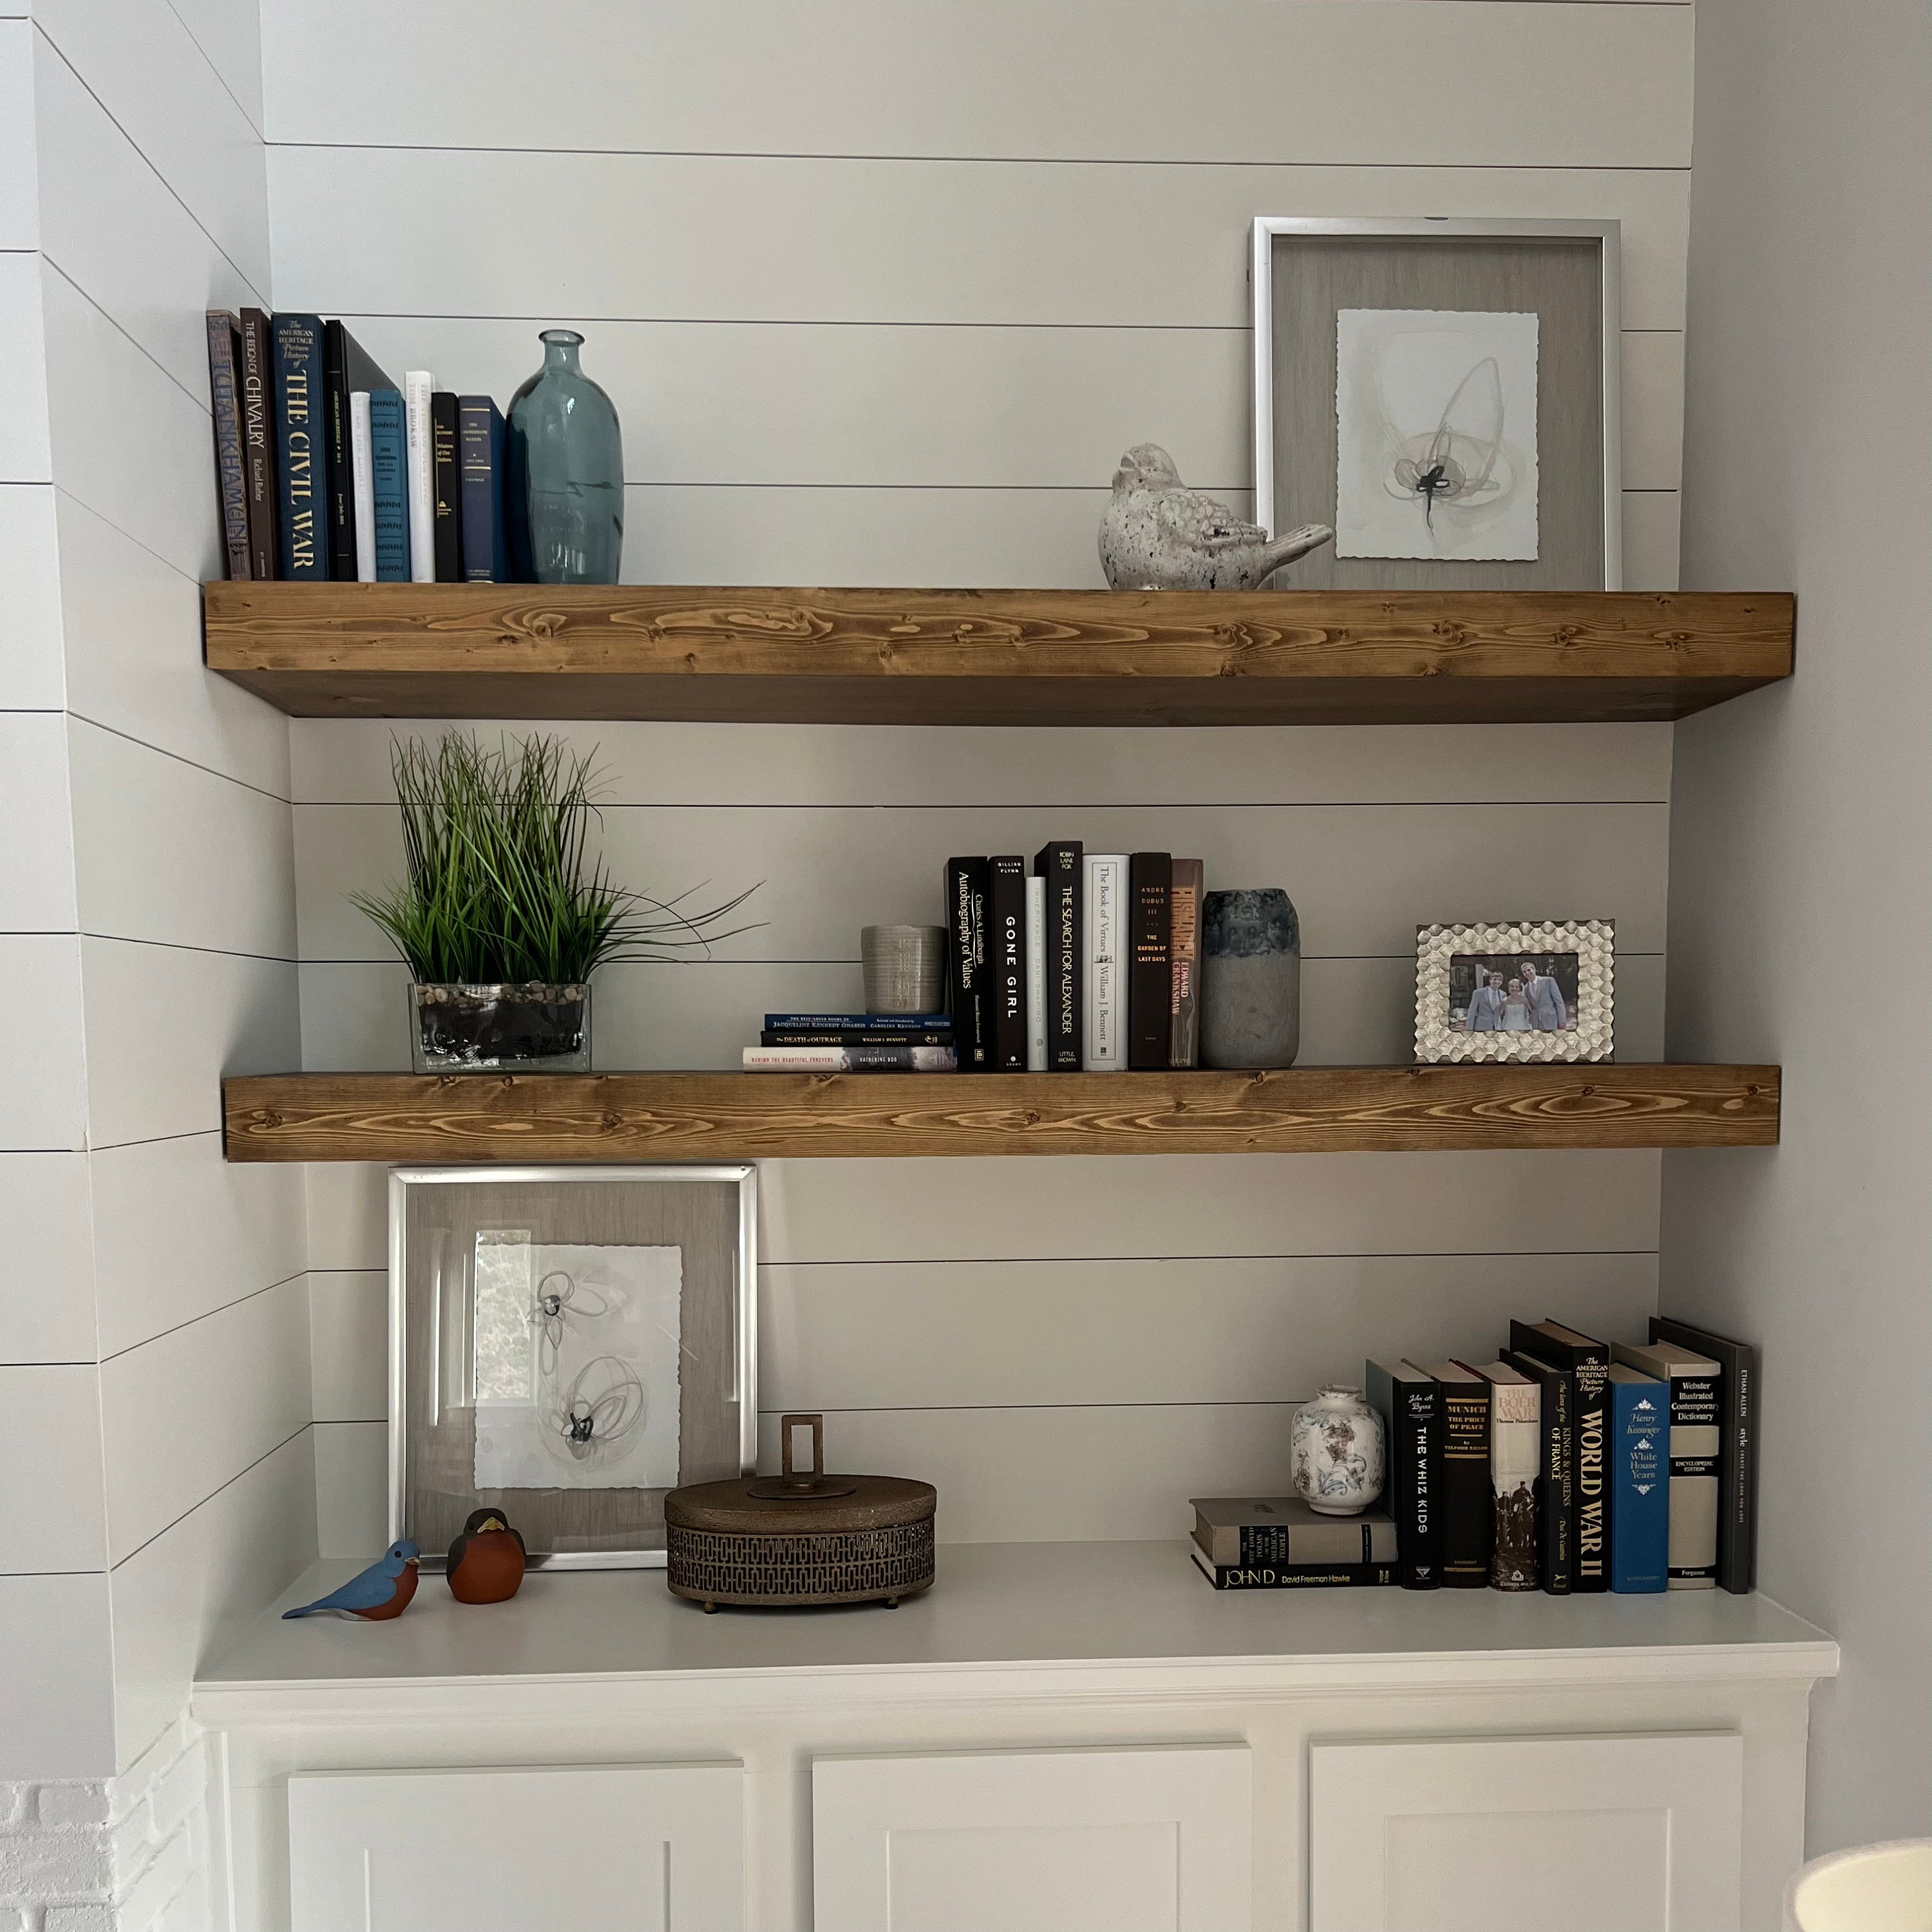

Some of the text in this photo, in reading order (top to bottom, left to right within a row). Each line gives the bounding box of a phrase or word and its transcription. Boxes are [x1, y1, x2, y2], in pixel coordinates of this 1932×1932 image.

[245, 321, 254, 338] THE
[278, 336, 314, 345] HERITAGE
[245, 339, 256, 363] REIGN
[248, 363, 257, 374] OF
[246, 376, 264, 449] CHIVALRY
[287, 370, 316, 569] THE CIVIL WAR
[975, 895, 983, 921] Charles
[1101, 866, 1110, 952] The Book of Virtues
[958, 871, 973, 989] Autobiography of Values
[976, 929, 985, 964] Lindbergh
[1006, 916, 1017, 1018] GONE GIRL
[1062, 886, 1072, 1034] THE SEARCH FOR ALEXANDER
[1100, 966, 1108, 999] William
[1172, 961, 1180, 1015] CRANKSHAW
[1180, 962, 1189, 998] EDWARD
[1100, 1010, 1108, 1040] Bennett
[1408, 1394, 1423, 1403] John
[1504, 1389, 1527, 1397] THE
[1579, 1385, 1604, 1393] History
[1588, 1392, 1598, 1401] of
[1412, 1403, 1431, 1412] Byrne
[1498, 1397, 1537, 1408] BOER
[1501, 1407, 1532, 1417] WAR
[1671, 1402, 1719, 1411] Contemporary
[1629, 1413, 1658, 1426] Henry
[1678, 1412, 1714, 1421] Dictionary
[1627, 1425, 1662, 1439] Kissinger
[1738, 1428, 1748, 1447] style
[1563, 1427, 1571, 1457] KINGS
[1551, 1427, 1560, 1480] OF FRANCE
[1630, 1452, 1658, 1461] White
[1631, 1461, 1658, 1469] House
[1632, 1470, 1656, 1479] Years
[1417, 1426, 1428, 1533] THE WHIZ KIDS
[1560, 1470, 1571, 1506] QUEENS
[1580, 1408, 1602, 1577] WORLD WAR II
[1224, 1569, 1260, 1588] JOHN
